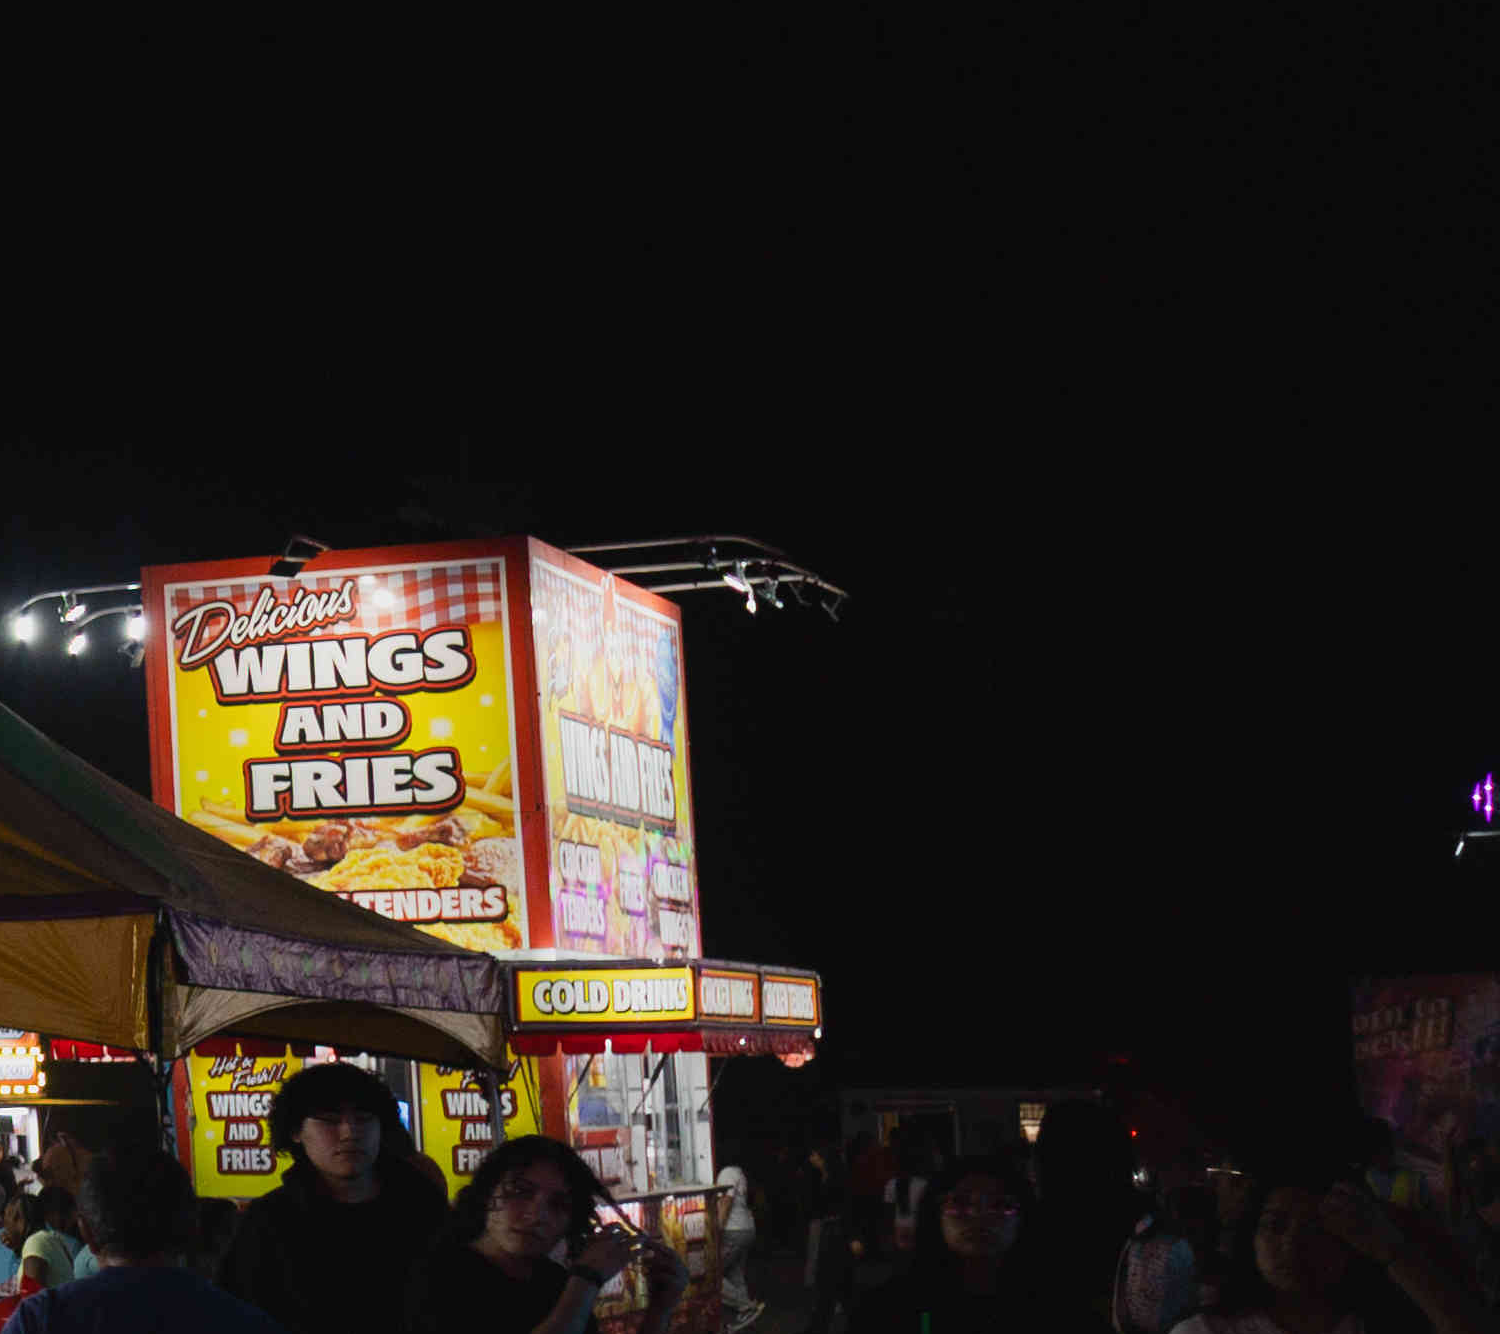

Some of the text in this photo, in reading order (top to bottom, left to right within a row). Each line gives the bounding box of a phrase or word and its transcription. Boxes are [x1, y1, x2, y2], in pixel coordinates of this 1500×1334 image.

[173, 580, 355, 665] Delicious
[213, 630, 470, 697] WINGS
[279, 701, 406, 745] AND
[249, 752, 459, 812] FRIES
[354, 887, 506, 922] TENDERS
[533, 978, 689, 1014] COLD DRINKS
[209, 1092, 273, 1117] WINGS
[445, 1091, 513, 1117] WINS
[228, 1122, 259, 1142] AND
[220, 1148, 272, 1172] FRIES
